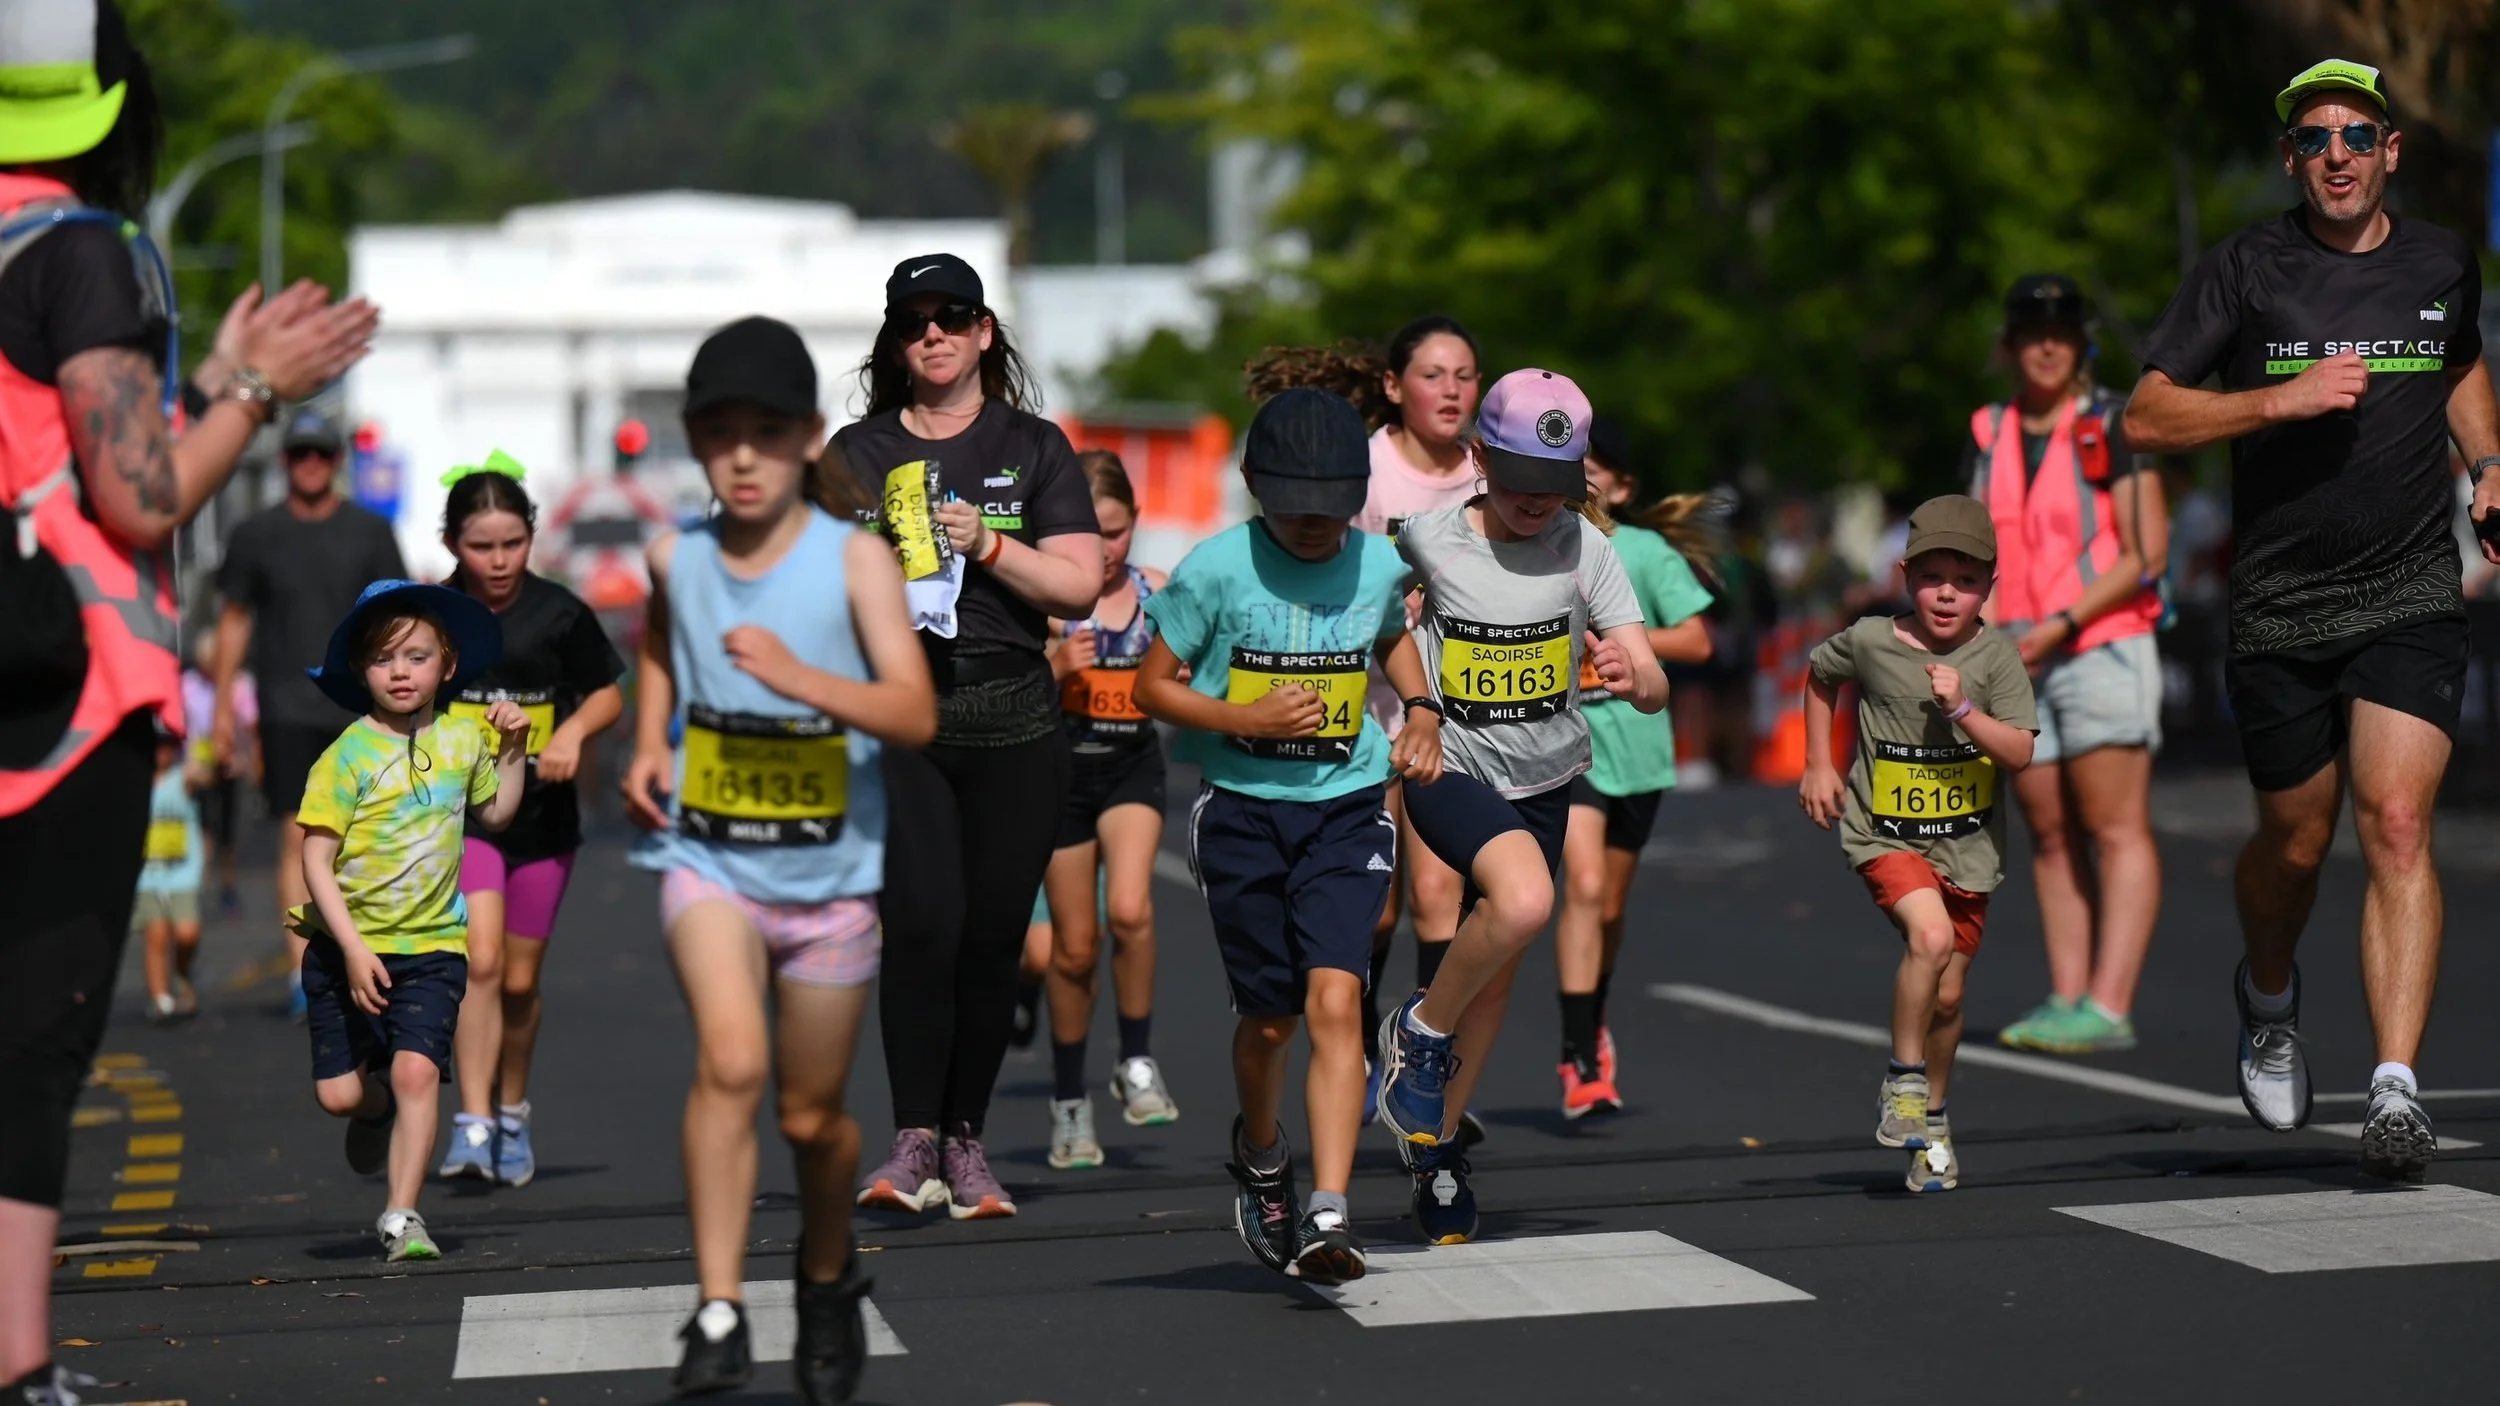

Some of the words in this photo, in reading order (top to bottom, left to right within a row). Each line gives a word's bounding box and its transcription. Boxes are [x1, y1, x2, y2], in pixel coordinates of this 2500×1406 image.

[2420, 310, 2444, 321] PUMA
[2266, 342, 2309, 357] THE
[984, 476, 1014, 488] PUMA
[910, 494, 929, 546] DUSTIN
[1246, 602, 1377, 651] NIKE
[1457, 623, 1481, 635] THE
[1487, 621, 1560, 639] SPECTACLE
[1243, 653, 1273, 666] THE
[1280, 654, 1358, 667] SPECTACLE
[1472, 646, 1544, 662] SAOIRSE
[1459, 664, 1555, 697] 16163
[1489, 707, 1526, 719] MILE
[1276, 743, 1316, 756] MILE
[1885, 744, 1909, 756] THE
[1915, 744, 1978, 758] SPECTACL
[1907, 767, 1964, 780] TADGH
[702, 768, 824, 808] 16135
[1891, 782, 1978, 813] 16161
[728, 820, 781, 842] MILE
[1919, 822, 1953, 835] MILE
